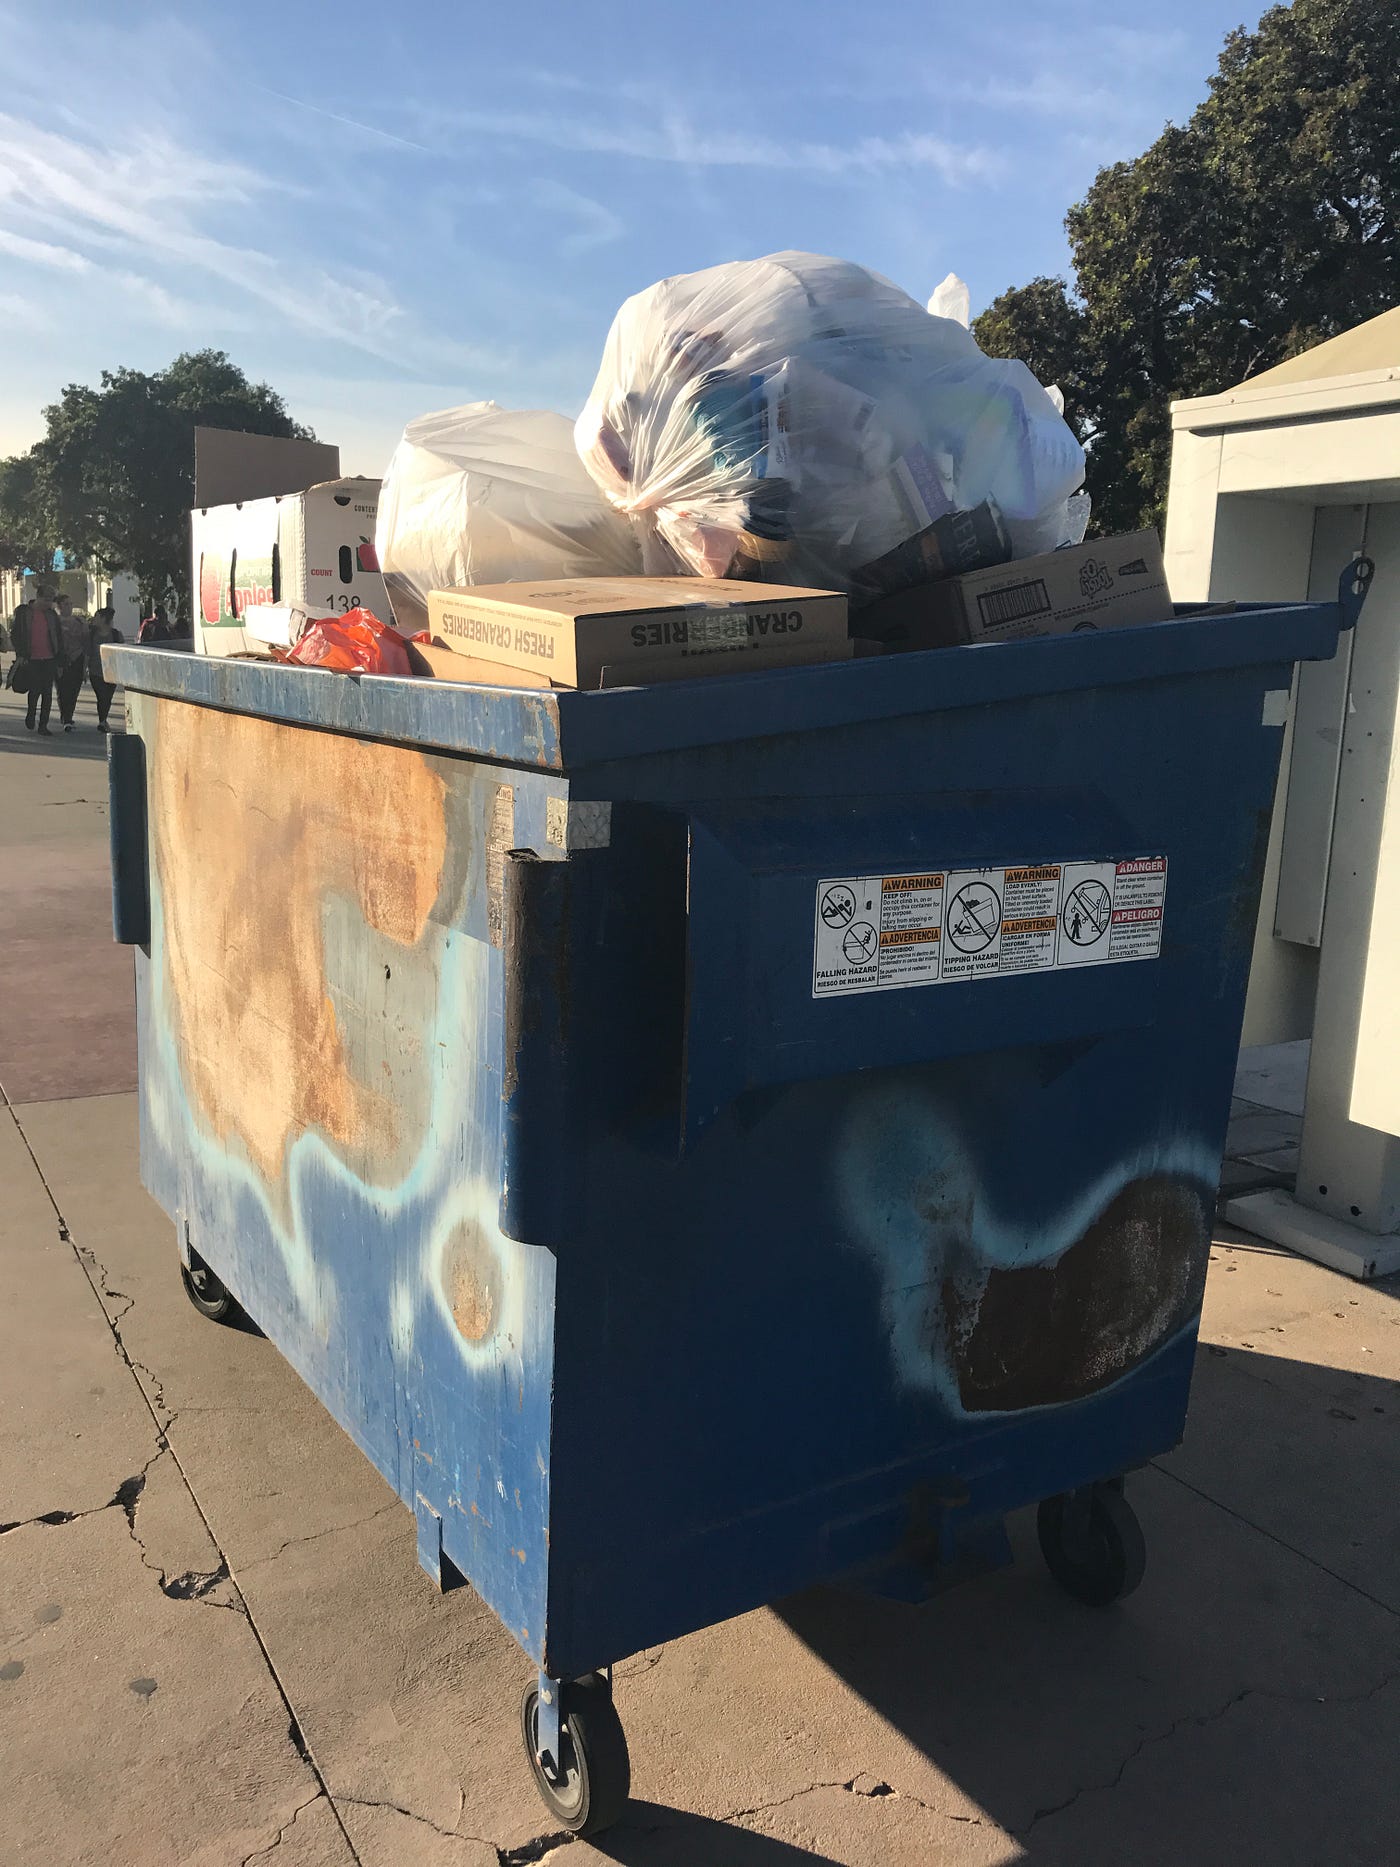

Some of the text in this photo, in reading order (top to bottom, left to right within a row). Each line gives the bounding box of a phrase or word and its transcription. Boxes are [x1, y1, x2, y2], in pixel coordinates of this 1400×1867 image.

[311, 569, 333, 577] COUNT
[326, 594, 361, 613] 138
[442, 613, 512, 648] CRANBERRIES
[630, 611, 803, 647] CRANRIES
[515, 629, 554, 659] FRESH
[1126, 861, 1162, 872] DANGER
[1014, 869, 1058, 880] WARNING
[892, 877, 941, 890] WARNING
[1122, 909, 1160, 920] PELIGRO
[1011, 919, 1055, 931] ADVERTENCIA
[890, 930, 938, 943] ADVERTENCIA
[945, 956, 970, 964] TIPPING
[973, 953, 998, 961] HAZARD
[817, 966, 877, 978] FALLING HAZARD
